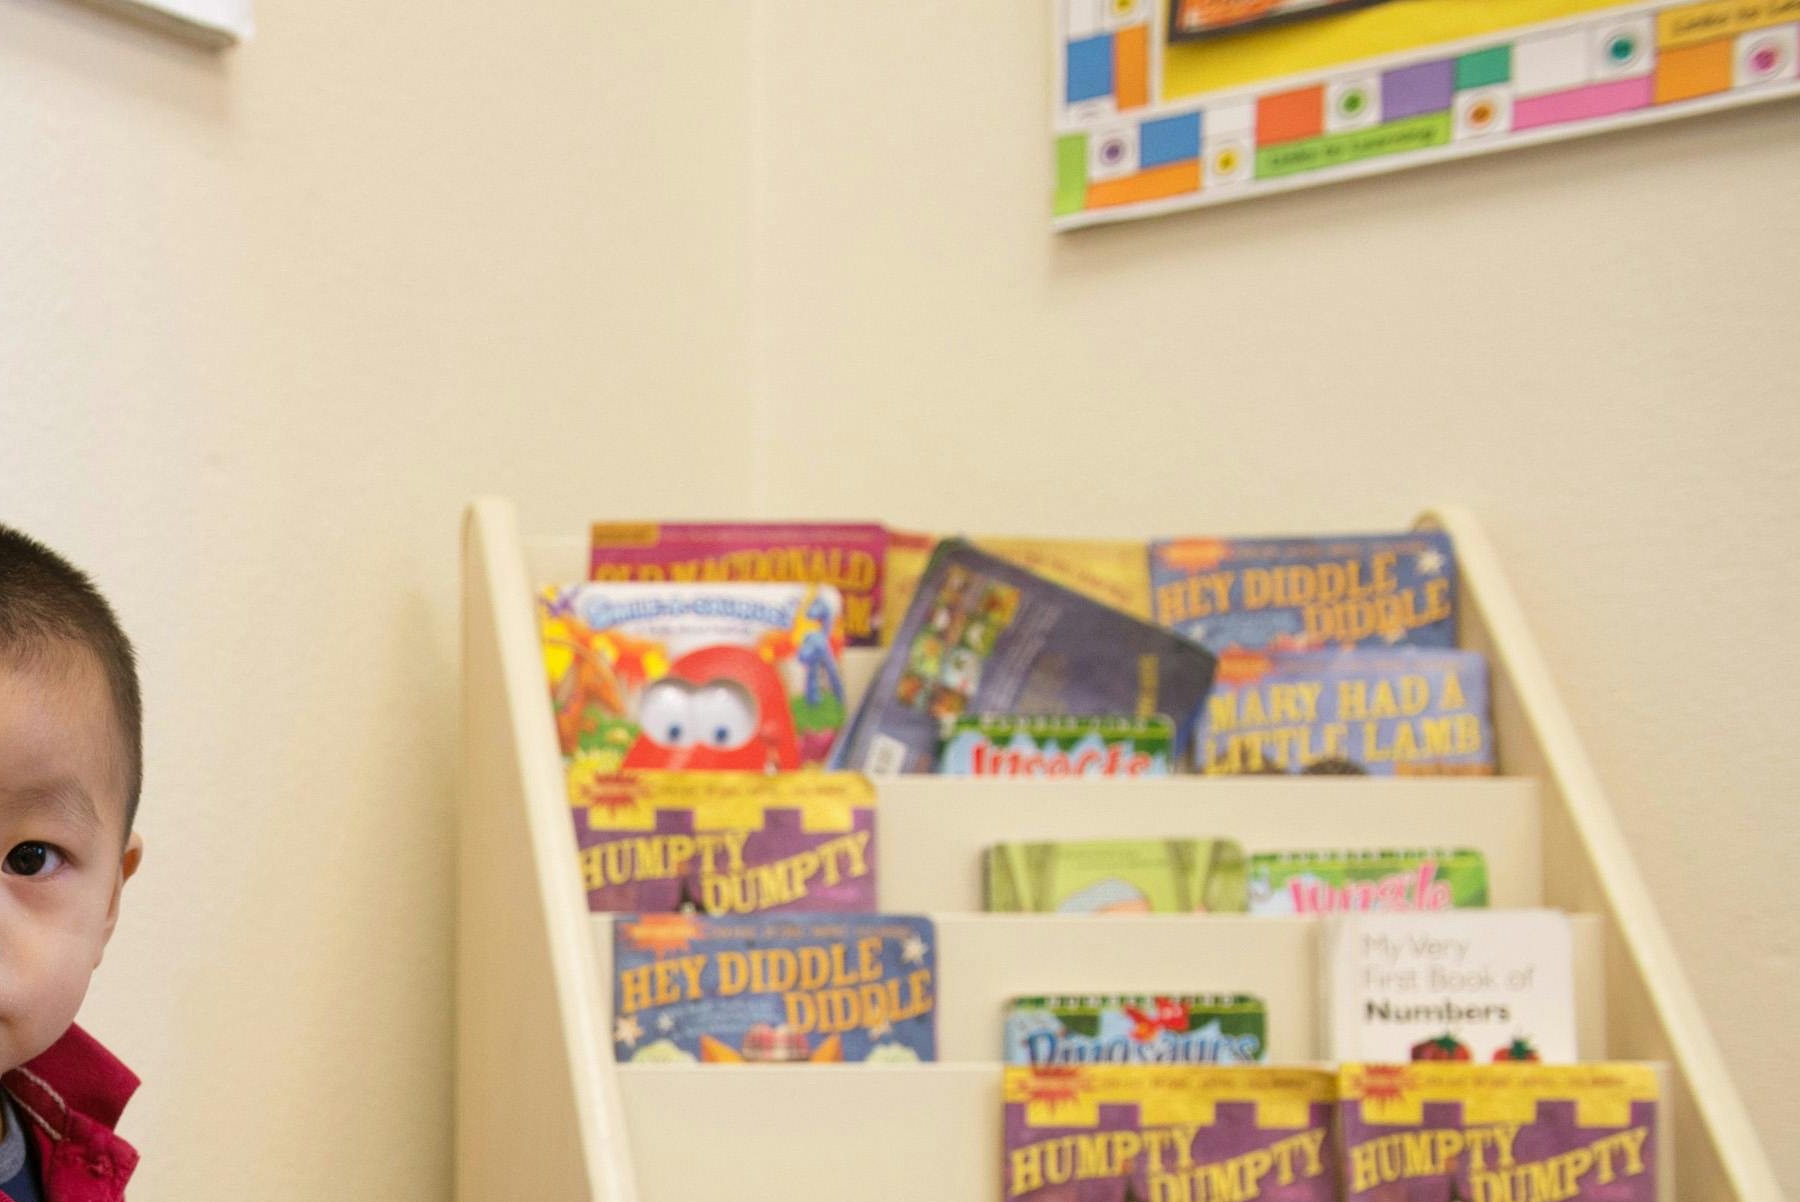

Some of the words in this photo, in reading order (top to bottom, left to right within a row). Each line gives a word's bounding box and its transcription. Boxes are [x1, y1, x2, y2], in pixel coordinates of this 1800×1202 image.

[1155, 568, 1234, 627] HEY
[1243, 551, 1397, 610] DIDDLE
[1302, 578, 1449, 640] DIDDLE
[1209, 682, 1322, 731] MARY
[1338, 676, 1430, 721] HAD
[1443, 671, 1466, 709] A
[1204, 723, 1349, 775] LITTLE
[1363, 714, 1482, 761] LAMB
[579, 829, 751, 891] HUMPTY
[701, 831, 871, 916] DUMPTY
[620, 954, 708, 1014] HEY
[718, 937, 885, 996] DIDDLE
[1363, 933, 1401, 961] My
[1408, 934, 1470, 961] Very
[1364, 966, 1416, 990] First
[1431, 965, 1495, 990] Book
[1508, 964, 1536, 990] of
[783, 969, 934, 1034] DIDDLE
[1365, 999, 1511, 1022] Numbers
[1009, 1123, 1201, 1197] HUMPTY
[1351, 1123, 1521, 1193] HUMPTY
